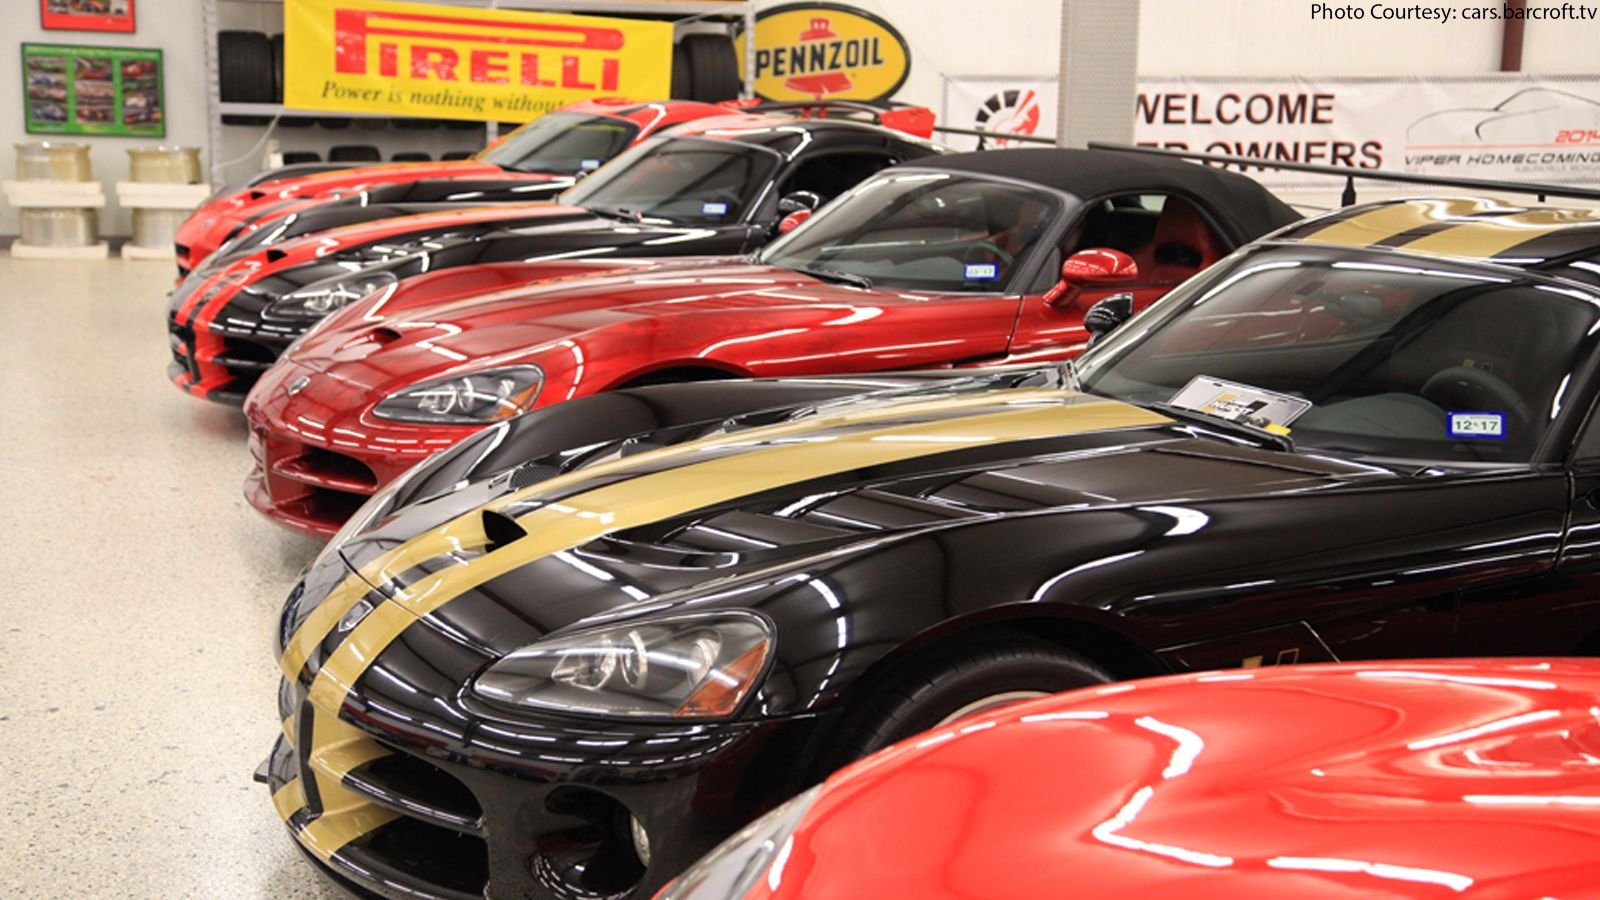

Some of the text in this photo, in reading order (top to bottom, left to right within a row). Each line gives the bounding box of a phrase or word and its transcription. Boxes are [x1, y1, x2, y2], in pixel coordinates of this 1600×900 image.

[334, 9, 625, 91] PIRELLI
[754, 38, 883, 78] PENNZOIL
[322, 80, 382, 102] Power
[388, 83, 402, 104] is
[410, 87, 485, 113] nothing
[1136, 93, 1334, 124] WELCOME
[1405, 154, 1461, 165] VIPER
